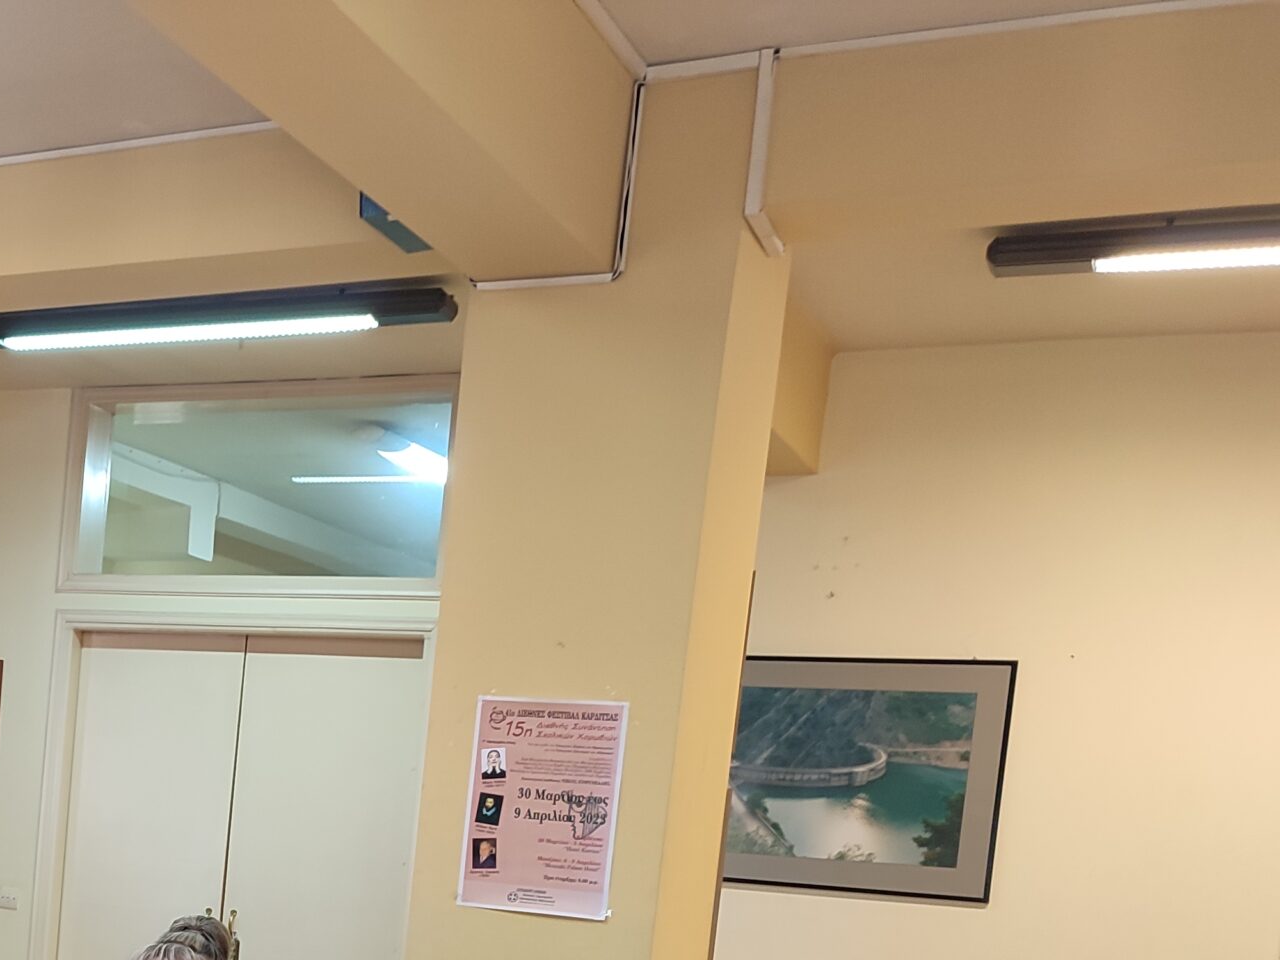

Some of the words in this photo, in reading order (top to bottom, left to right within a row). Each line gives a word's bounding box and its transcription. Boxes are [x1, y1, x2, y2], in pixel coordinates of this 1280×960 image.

[517, 709, 545, 719] ΔΙΕΘΝΕΣ
[547, 710, 580, 720] ΦΕΣΤΙΒΑΛ
[581, 711, 619, 722] ΚΑΡΔΙΤΣΑΣ
[517, 787, 531, 799] 30
[514, 807, 521, 819] 9
[523, 808, 575, 824] Απριλίου
